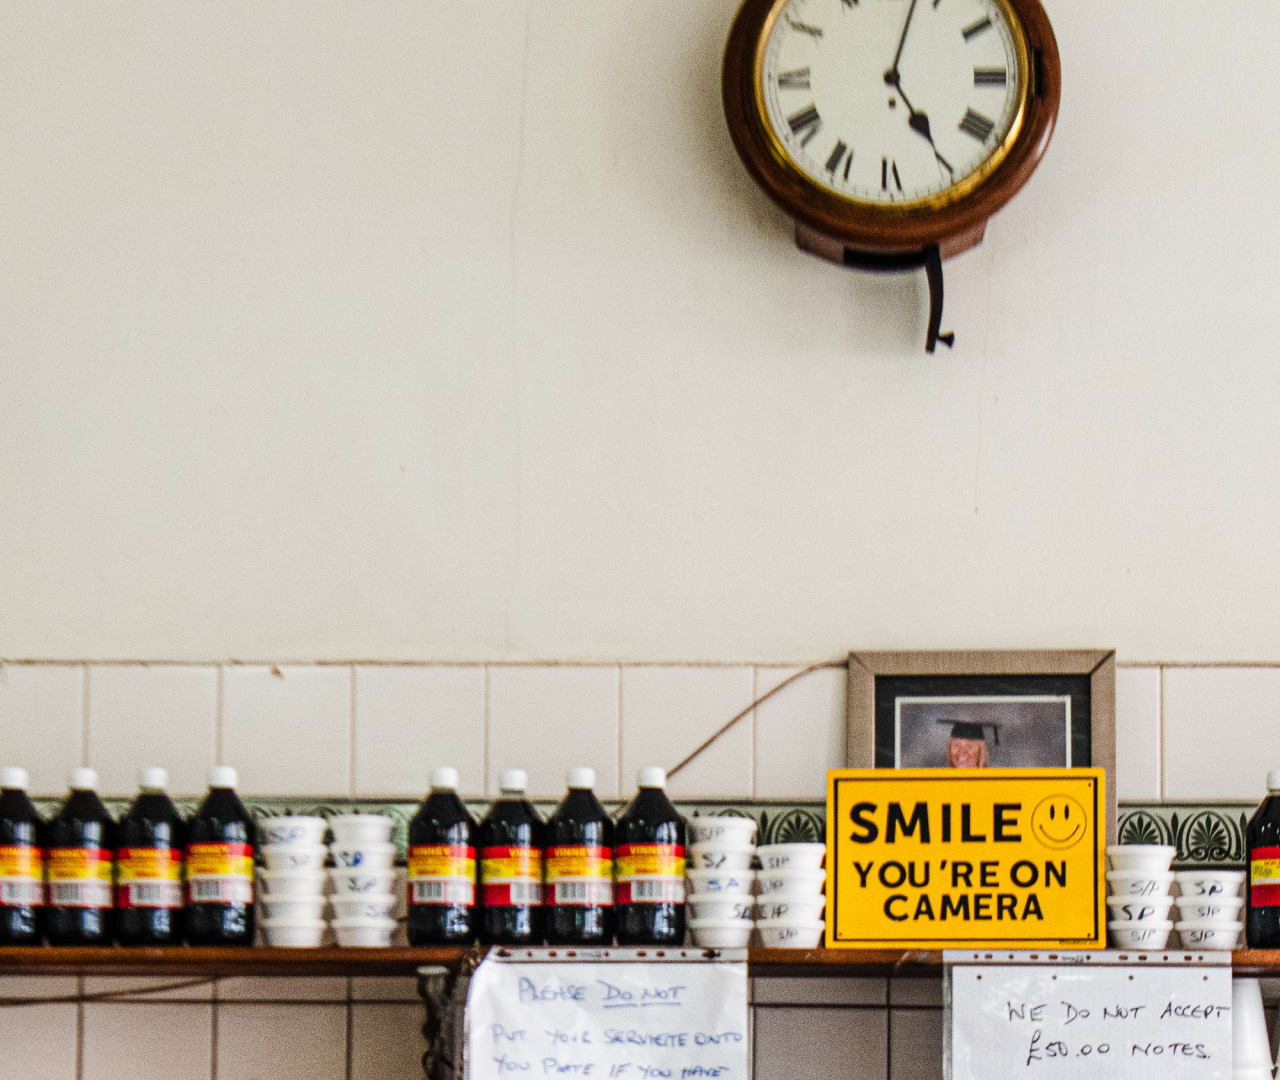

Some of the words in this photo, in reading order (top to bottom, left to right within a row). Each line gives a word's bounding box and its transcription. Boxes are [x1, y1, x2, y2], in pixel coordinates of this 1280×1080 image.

[849, 801, 1022, 844] SMILE
[853, 860, 1000, 888] YOU'RE
[1010, 860, 1067, 888] ON
[884, 893, 1045, 922] CAMERA
[1007, 1001, 1046, 1022] WE
[1160, 1001, 1231, 1021] ACCEPT
